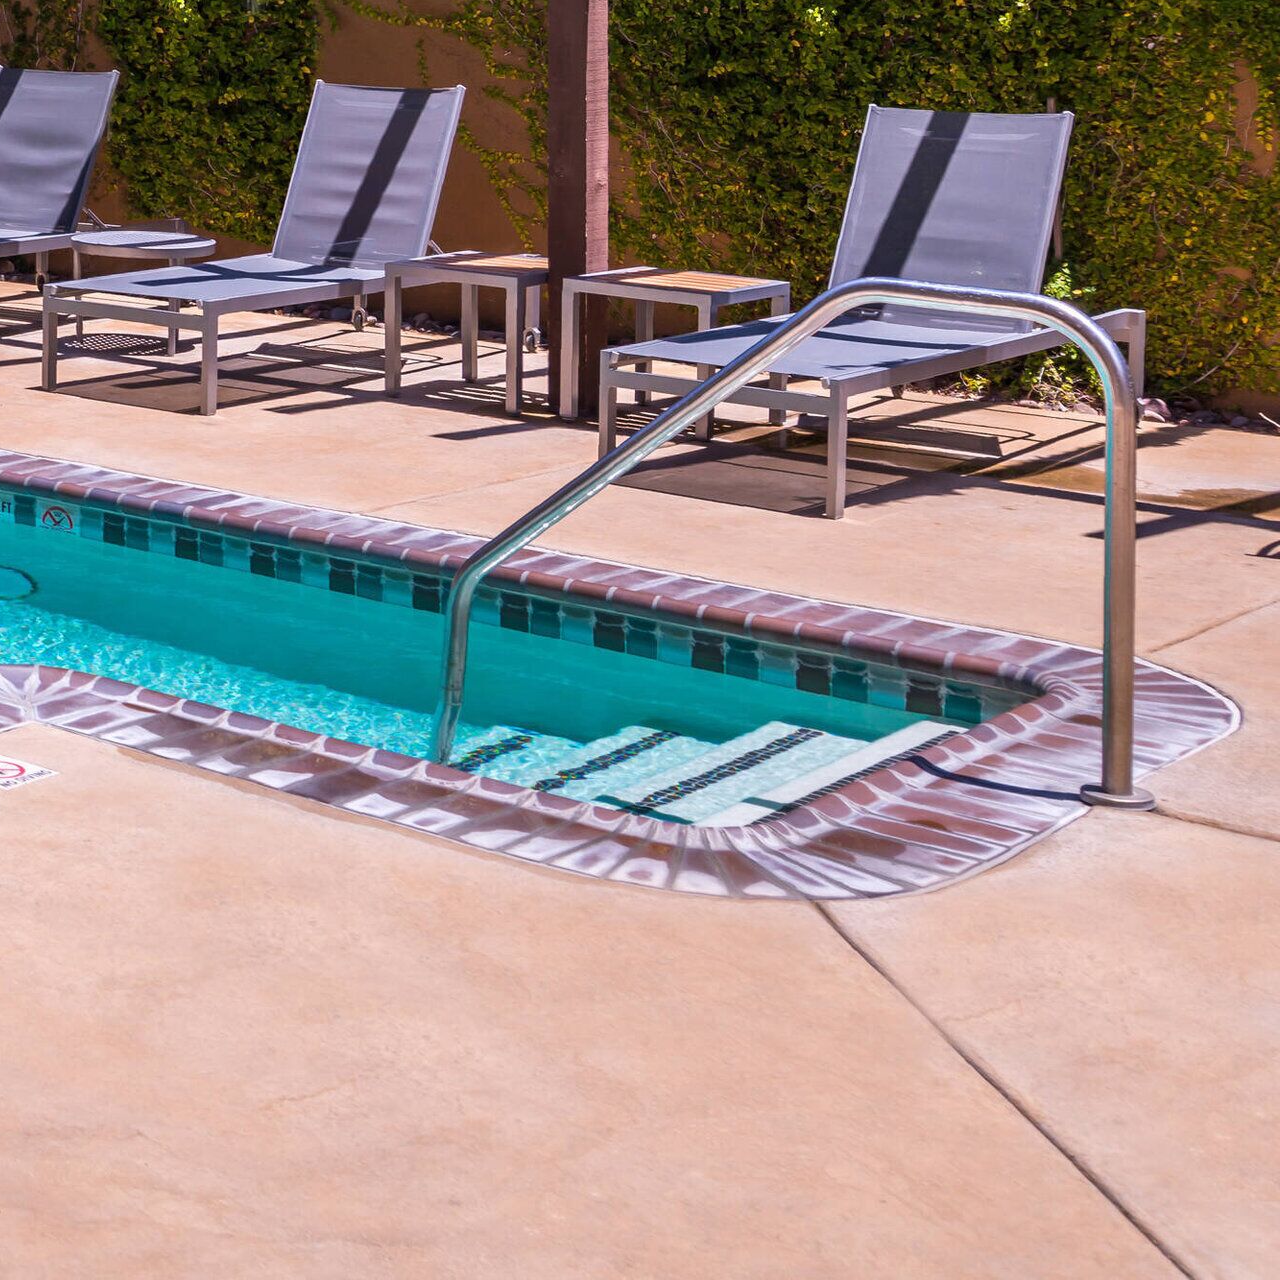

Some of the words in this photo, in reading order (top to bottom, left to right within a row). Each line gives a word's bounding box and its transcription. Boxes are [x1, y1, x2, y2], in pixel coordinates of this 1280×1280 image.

[2, 502, 12, 514] FT
[0, 779, 18, 788] NO
[17, 770, 53, 783] DIVING
